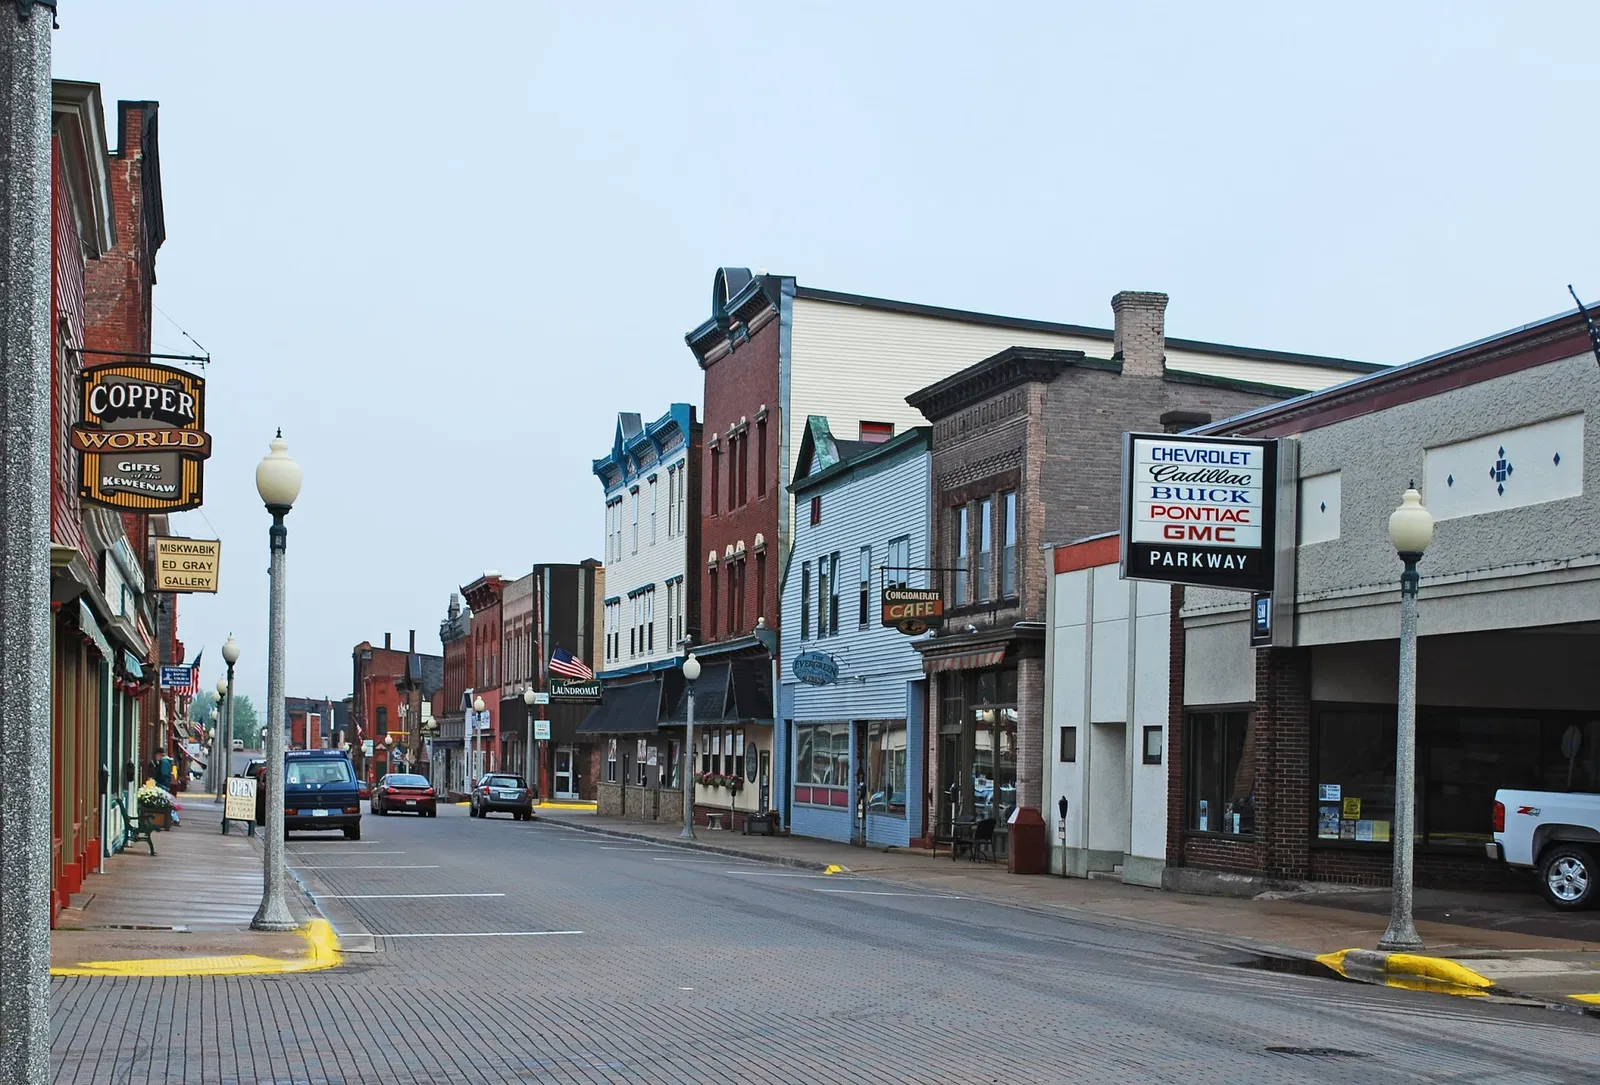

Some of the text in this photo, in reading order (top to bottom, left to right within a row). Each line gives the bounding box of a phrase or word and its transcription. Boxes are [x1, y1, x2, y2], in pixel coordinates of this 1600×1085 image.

[90, 385, 194, 419] COPPER
[75, 430, 205, 449] WORLD
[1152, 447, 1251, 465] CHEVROLET
[117, 461, 161, 472] GIFTS
[1149, 464, 1251, 486] Cadillac
[102, 476, 176, 492] KEWEENAW
[1150, 486, 1251, 503] BUICK
[1150, 505, 1250, 523] PONTIAC
[1163, 525, 1236, 542] GMC
[160, 543, 215, 555] MISKWABIK
[162, 560, 213, 571] ED GRAY
[1150, 551, 1247, 570] PARKWAY
[164, 576, 211, 586] GALLERY
[885, 589, 940, 601] CONGLOMERATE
[890, 601, 935, 618] CAFE
[552, 685, 599, 695] LAUNDROMAT
[228, 779, 254, 798] OPEN
